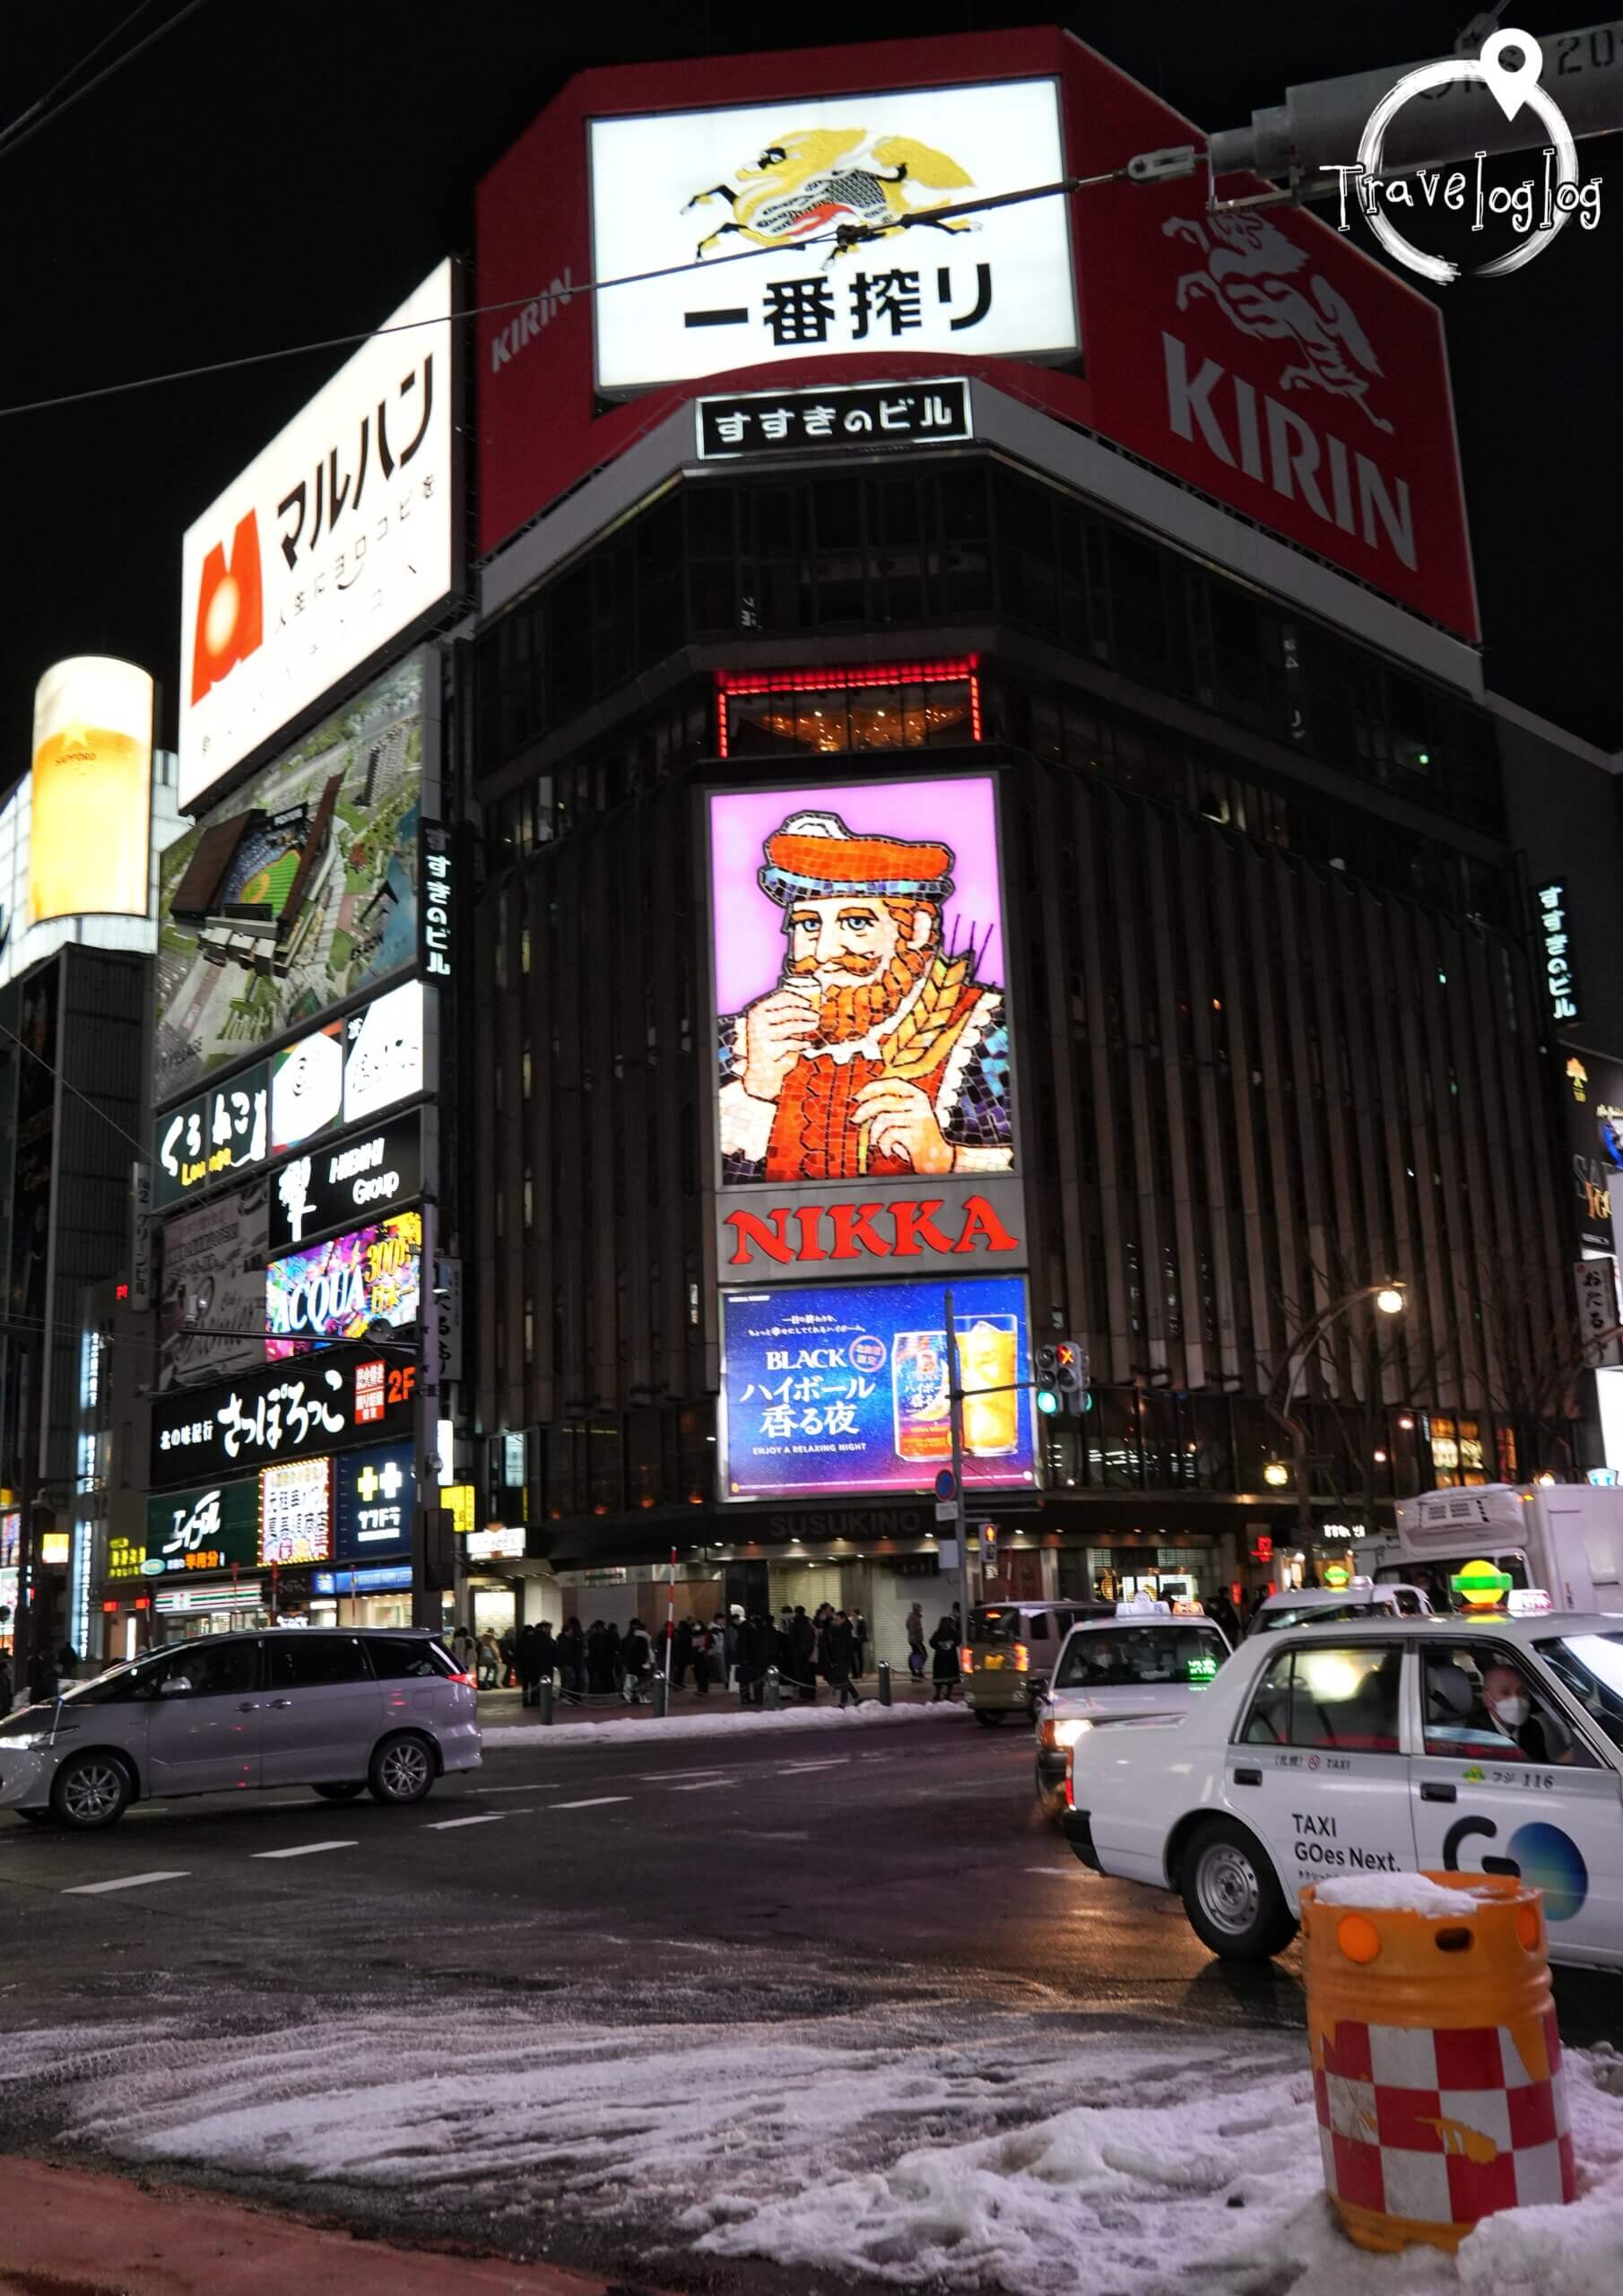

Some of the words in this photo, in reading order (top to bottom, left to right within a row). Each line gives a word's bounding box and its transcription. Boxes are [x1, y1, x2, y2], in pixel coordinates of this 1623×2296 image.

[490, 266, 574, 372] KIRIN
[684, 263, 993, 346] 一番搾り
[715, 393, 953, 442] すすきのビル
[276, 352, 434, 572] マルハン
[1161, 330, 1419, 573] KIRIN
[724, 1196, 1020, 1265] NIKKA
[273, 1264, 367, 1335] ACQUA
[766, 1348, 847, 1370] BLACK
[387, 1366, 417, 1404] 2F
[740, 1376, 877, 1404] ハイボール
[759, 1404, 861, 1439] 香る夜
[752, 1446, 782, 1456] ENJOY
[784, 1446, 791, 1454] A
[793, 1444, 837, 1453] RELAXING
[838, 1442, 867, 1452] NIGHT
[768, 1510, 921, 1537] SUSUKINO
[1326, 1758, 1351, 1770] TAXI
[1522, 1773, 1555, 1789] 116
[1291, 1813, 1337, 1838] TAXI
[1294, 1841, 1345, 1866] GOes
[1348, 1846, 1401, 1873] Next.
